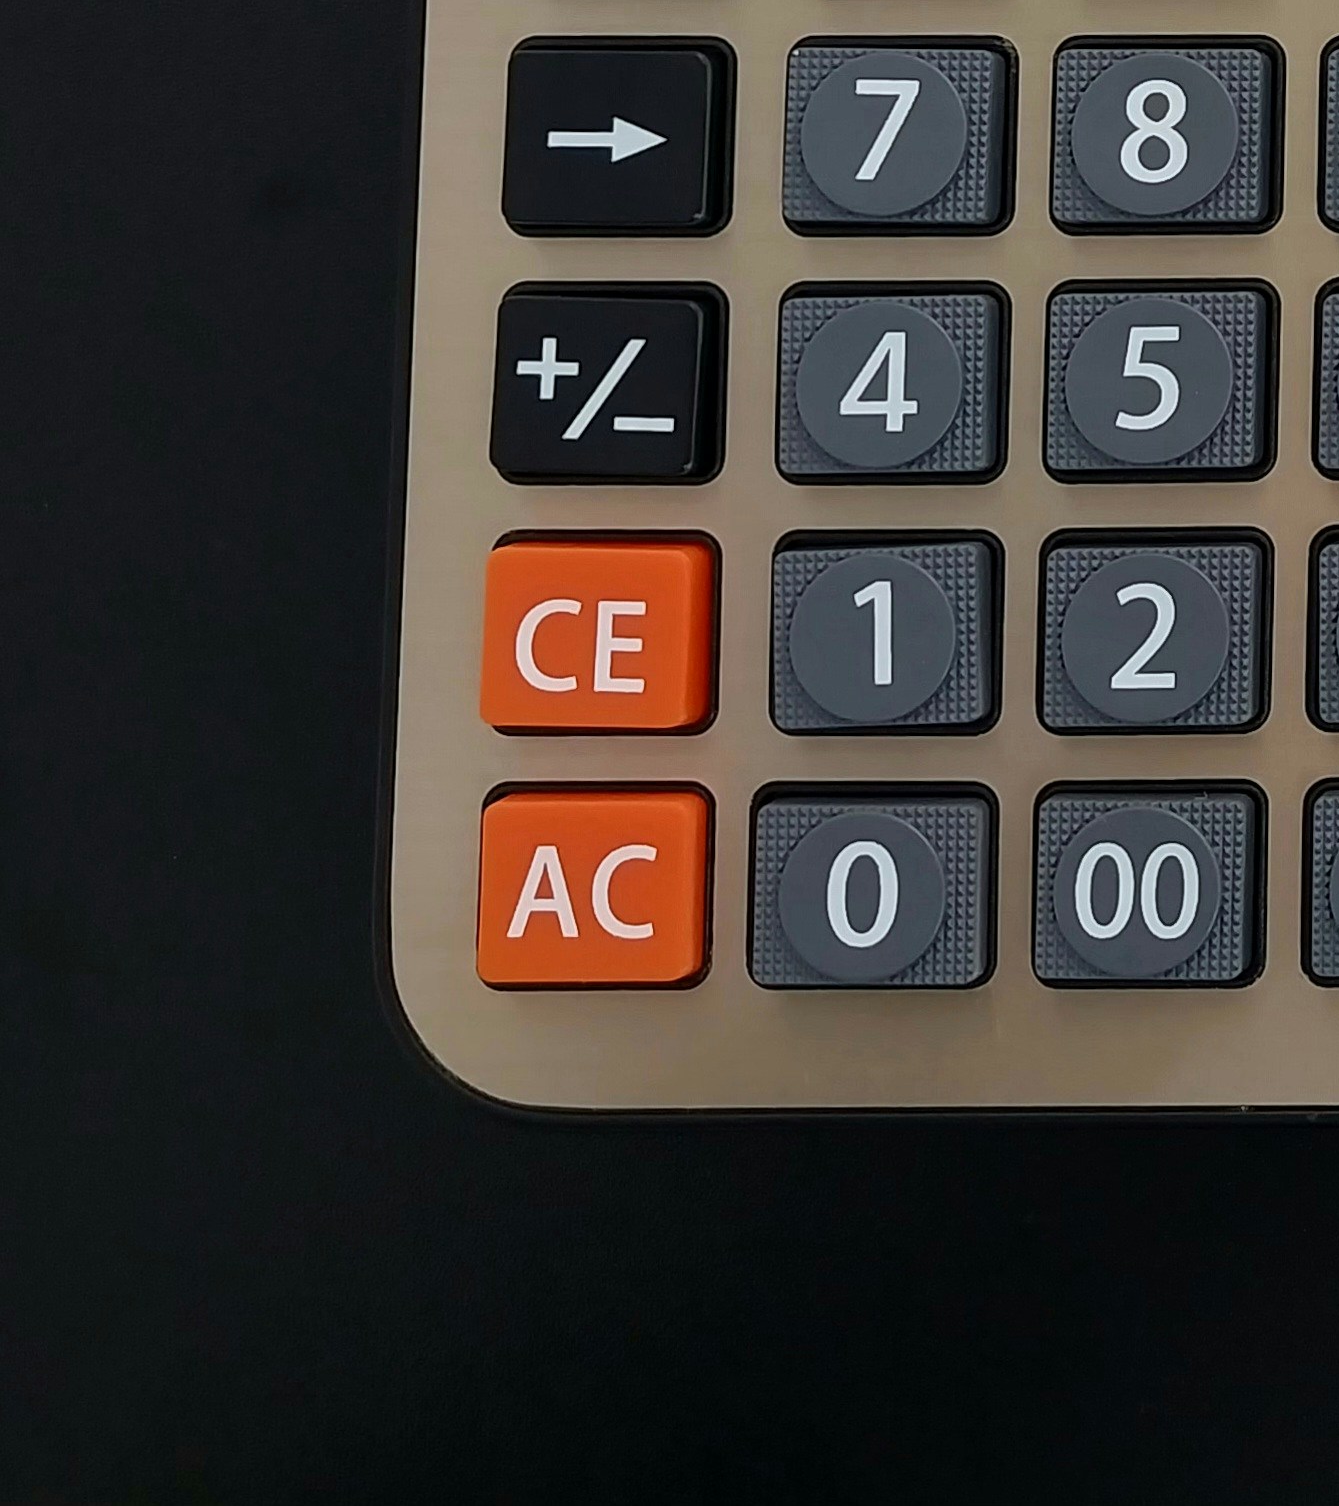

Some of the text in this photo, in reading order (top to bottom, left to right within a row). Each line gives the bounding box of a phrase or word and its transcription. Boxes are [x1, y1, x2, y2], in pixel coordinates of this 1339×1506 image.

[855, 79, 920, 180] 7
[1120, 79, 1188, 184] 8
[839, 331, 918, 432] 4
[1115, 326, 1180, 430] 5
[515, 598, 647, 694] CE
[853, 581, 892, 685] 1
[1110, 582, 1176, 689] 2
[506, 844, 658, 940] AC
[826, 841, 899, 948] 0
[1074, 842, 1199, 940] 00
